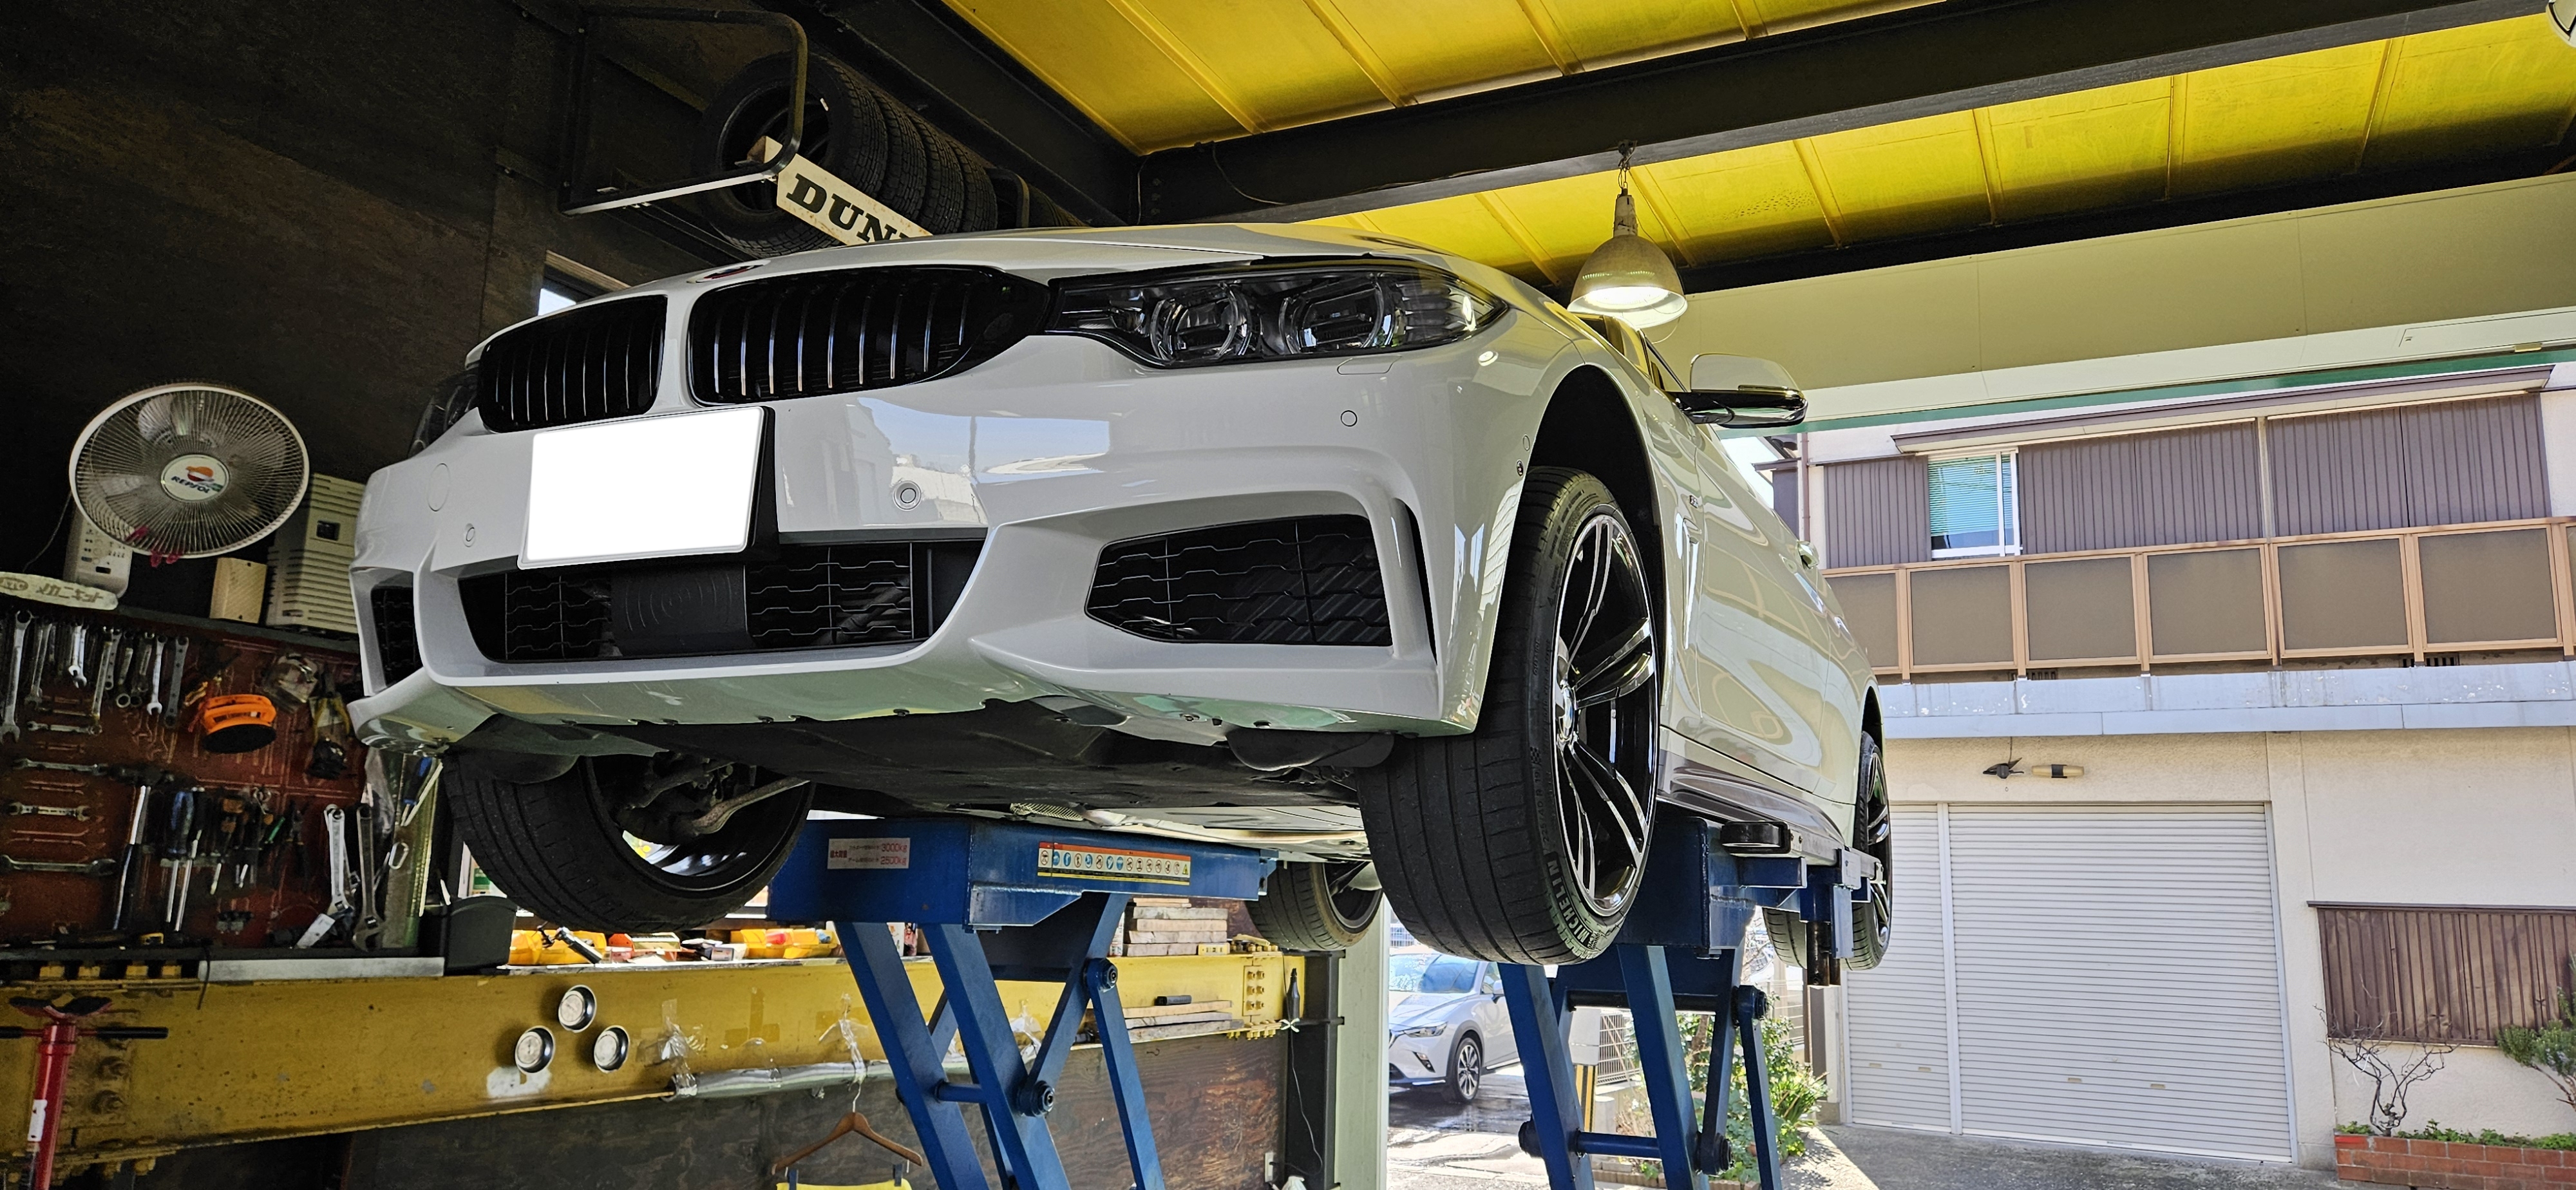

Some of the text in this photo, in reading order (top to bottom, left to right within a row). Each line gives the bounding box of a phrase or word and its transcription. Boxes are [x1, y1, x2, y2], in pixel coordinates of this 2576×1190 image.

[786, 173, 910, 243] DUN
[171, 476, 211, 493] REPSOL
[882, 843, 907, 853] 3000kg
[1548, 860, 1590, 943] MICHELIN
